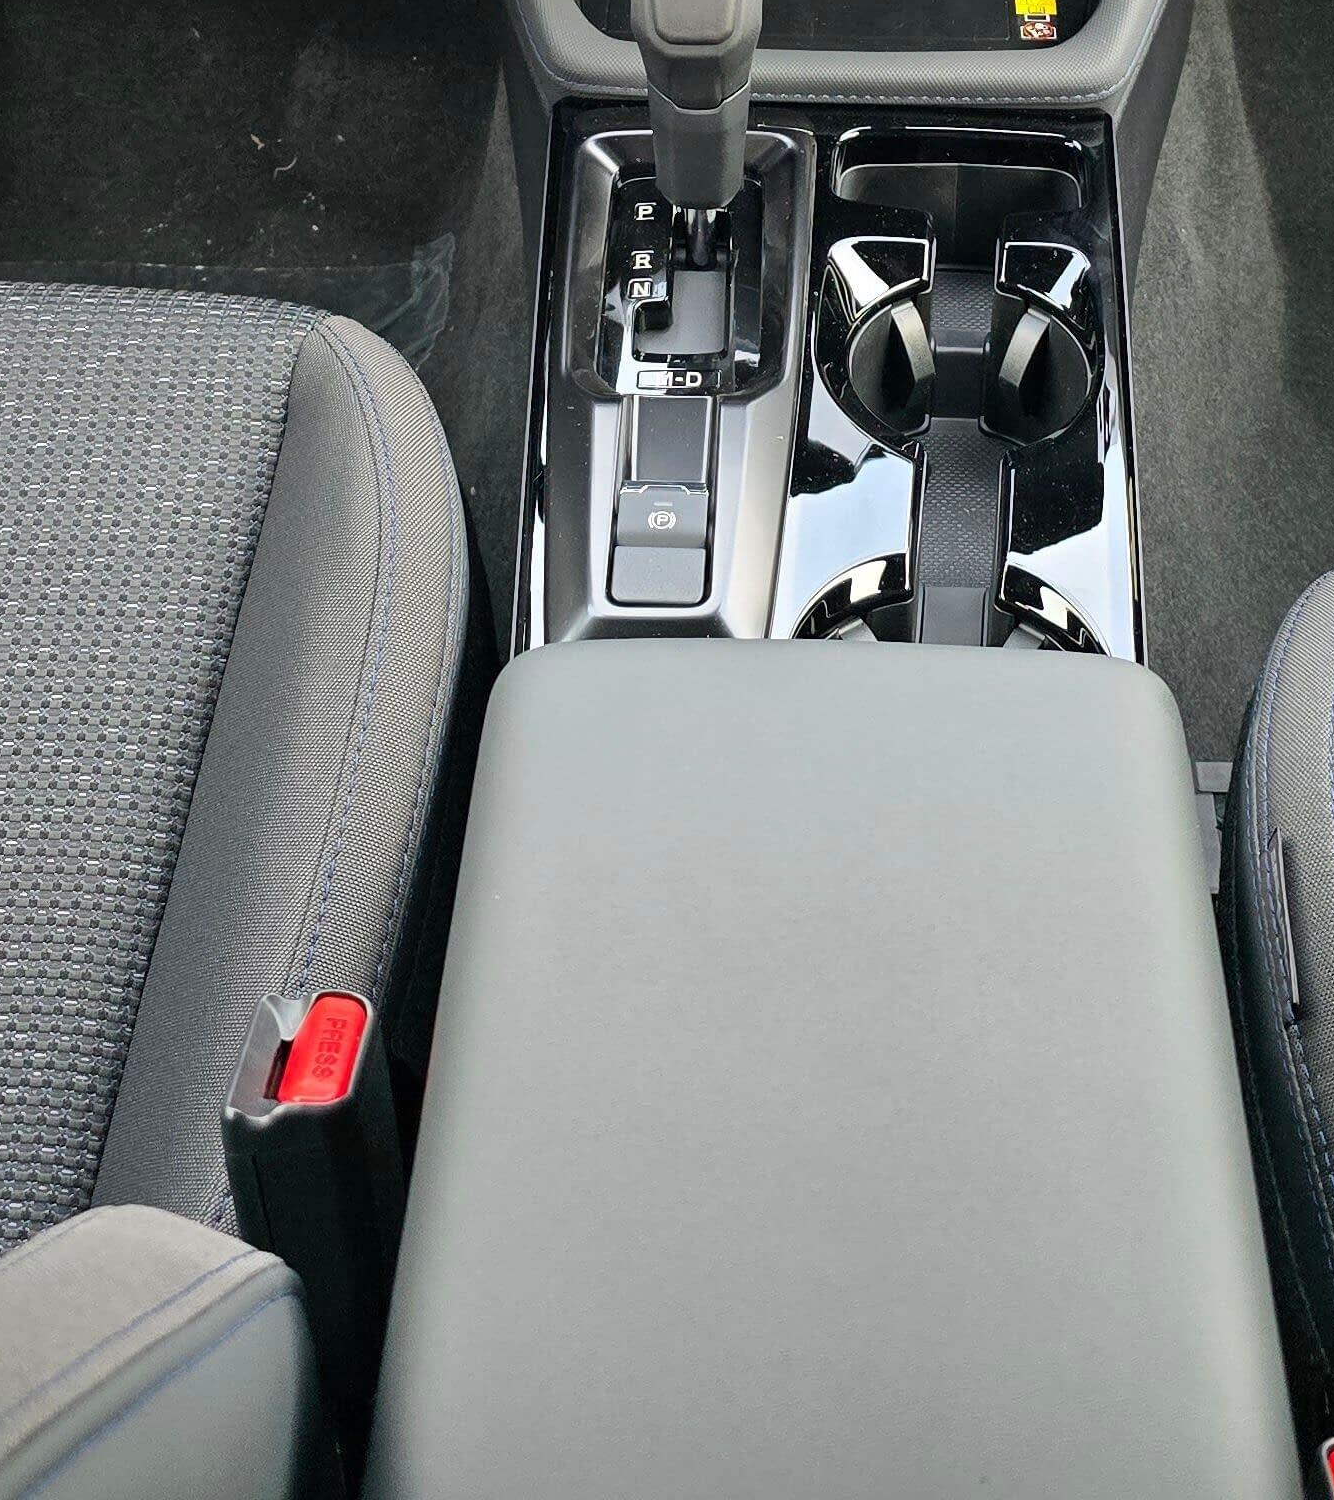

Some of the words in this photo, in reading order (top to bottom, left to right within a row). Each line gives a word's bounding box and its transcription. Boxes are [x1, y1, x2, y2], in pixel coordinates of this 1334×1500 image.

[633, 257, 652, 269] R
[632, 281, 651, 298] N
[311, 1018, 347, 1078] PRESS
